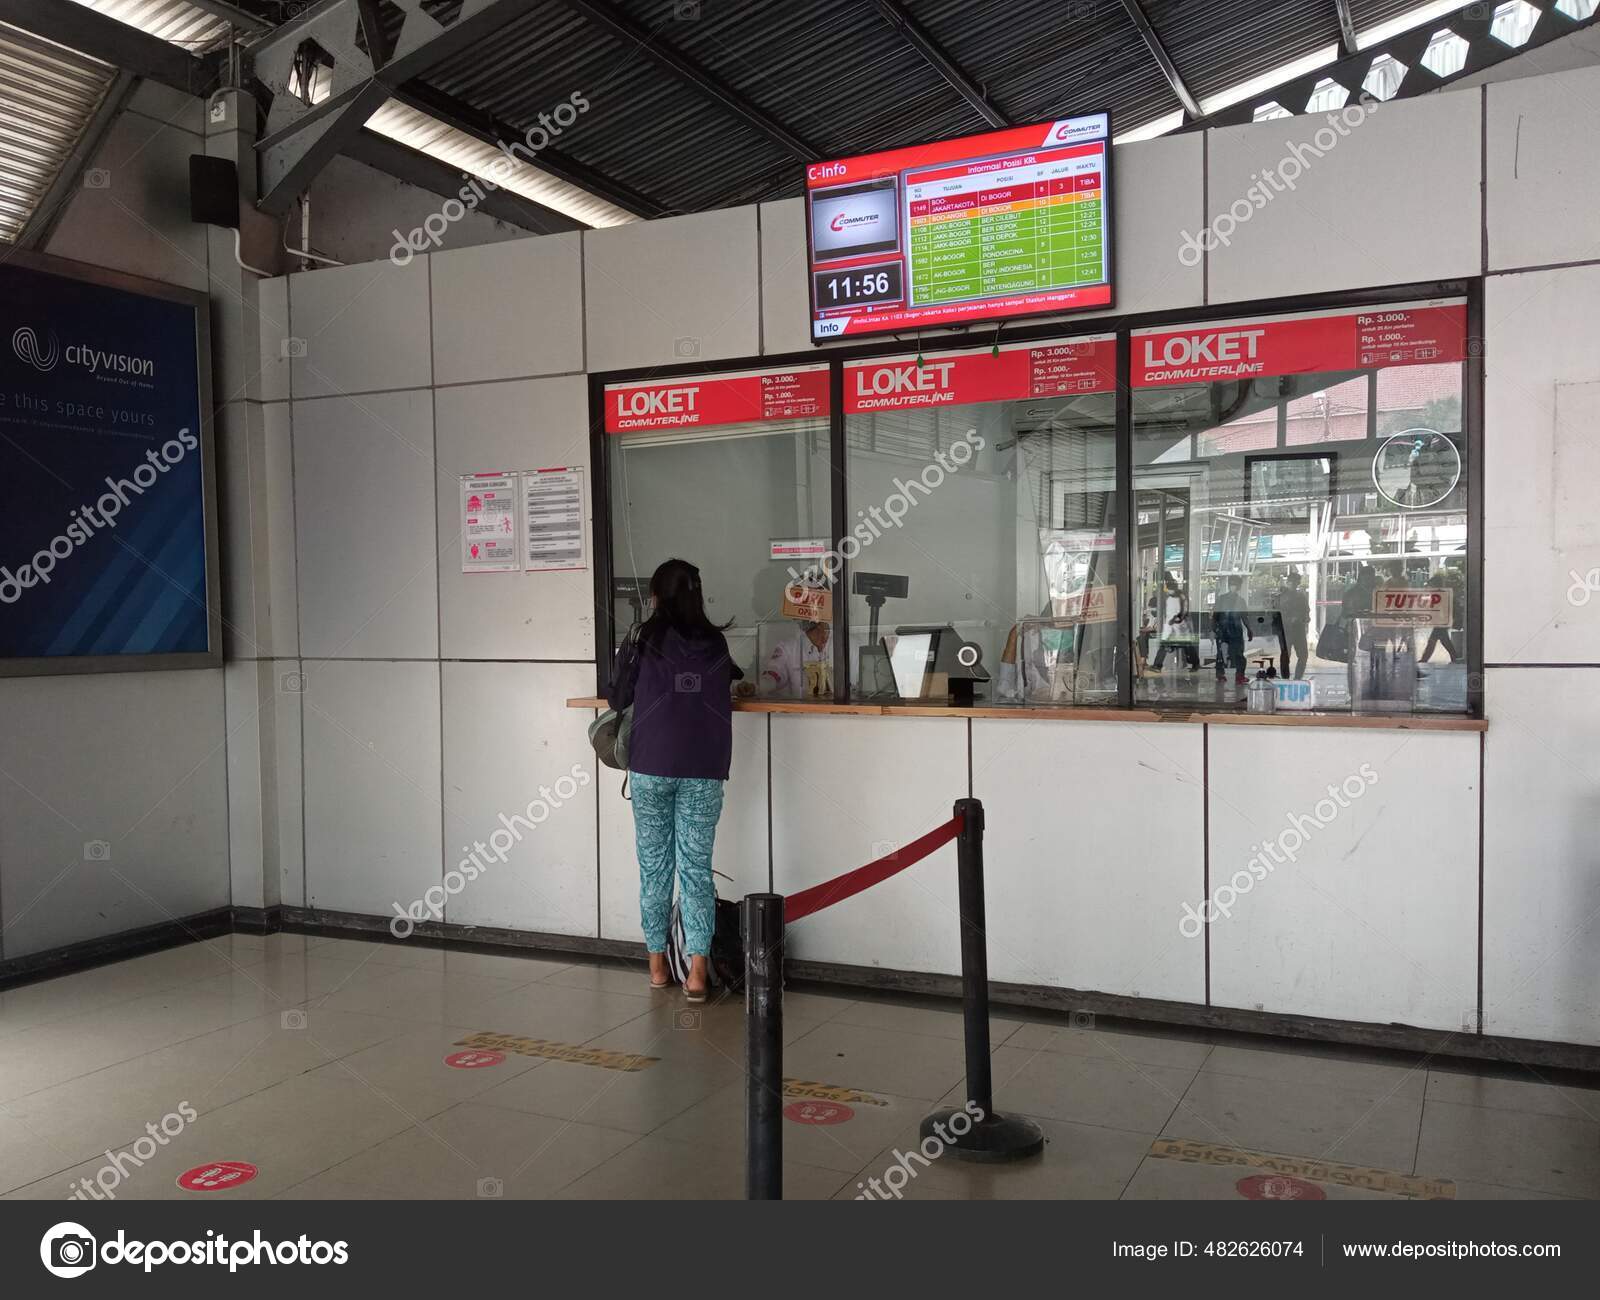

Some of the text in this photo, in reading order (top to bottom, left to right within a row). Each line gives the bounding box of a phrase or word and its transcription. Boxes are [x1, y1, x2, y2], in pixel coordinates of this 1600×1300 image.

[808, 163, 847, 180] C-Info
[967, 155, 1037, 174] Informasi Posisi KRL
[1080, 178, 1095, 186] TIBA
[988, 191, 1012, 201] BOGOR
[931, 201, 975, 213] JAKARTAKOTA
[839, 214, 879, 226] COMMUTER
[827, 272, 890, 301] 11:56
[988, 301, 1004, 310] hanya
[1357, 313, 1410, 326] Rp. 3.000,-
[819, 322, 839, 334] Info
[1361, 336, 1376, 344] Rp.
[1031, 350, 1045, 359] Rp.
[1144, 330, 1265, 368] LOKET
[65, 344, 154, 377] cityvision
[857, 362, 955, 396] LOKET
[1034, 368, 1047, 376] Rp.
[1144, 362, 1264, 382] COMMUTERLINE
[762, 377, 774, 385] Rp.
[617, 387, 700, 416] LOKET
[857, 391, 954, 409] COMMUTERLINE
[15, 392, 49, 412] this
[56, 400, 104, 420] space
[111, 407, 155, 426] yours
[618, 414, 700, 428] COMMUTERLINE
[1384, 594, 1442, 608] TUTUP
[1167, 1145, 1247, 1166] Batas
[1261, 1158, 1373, 1185] Antrian
